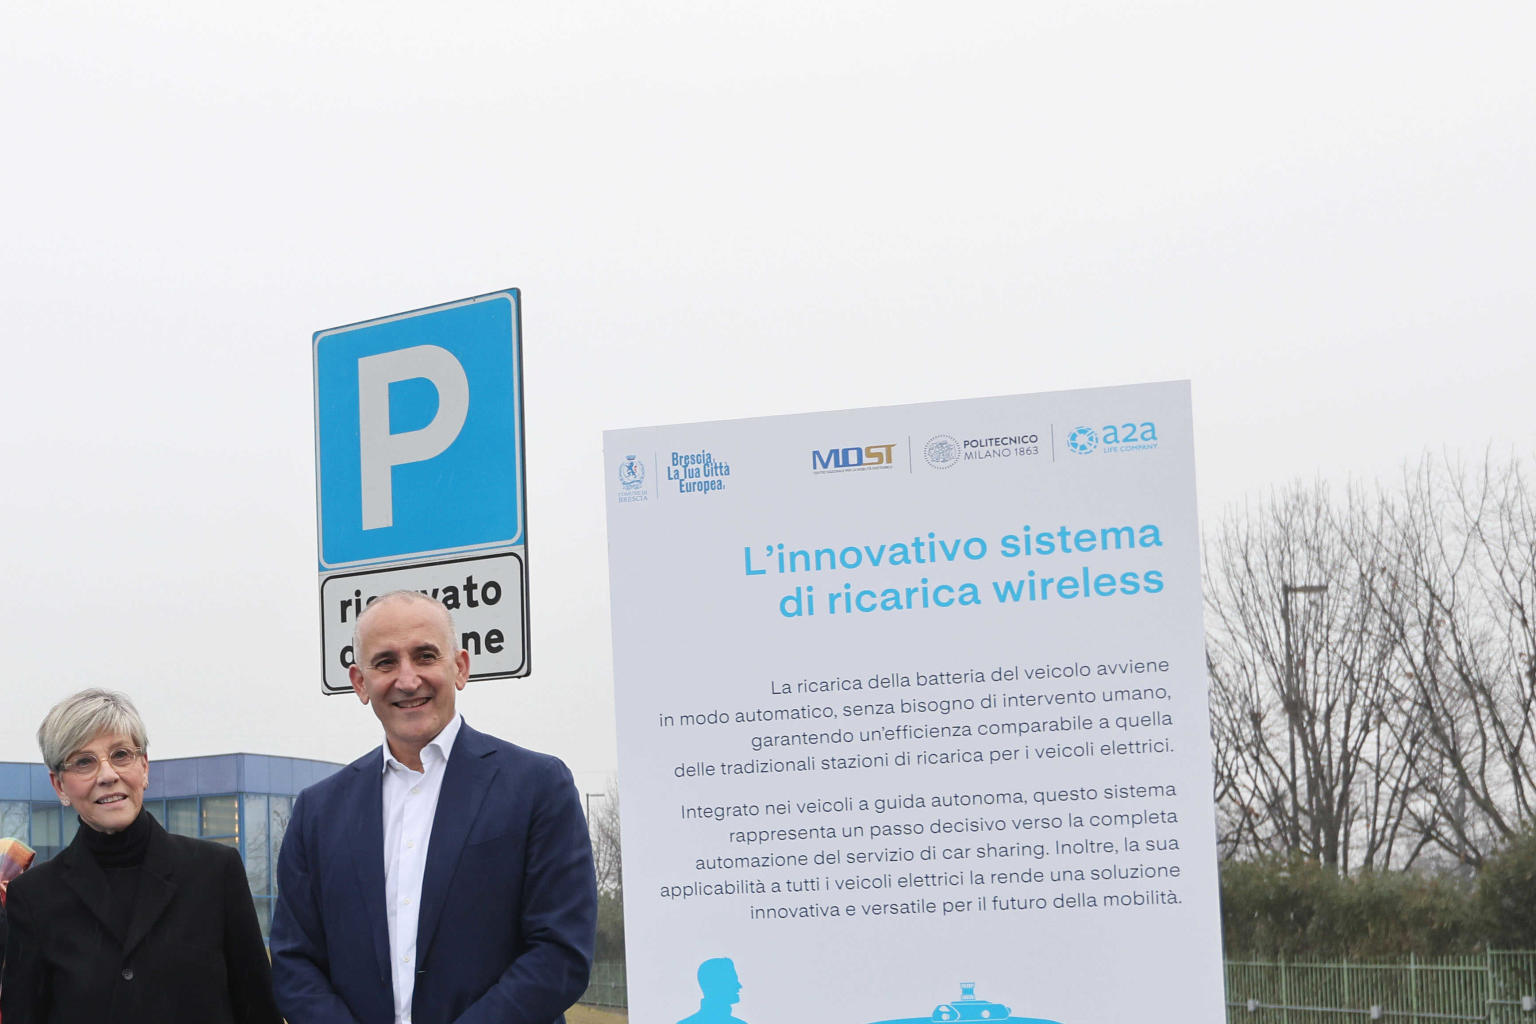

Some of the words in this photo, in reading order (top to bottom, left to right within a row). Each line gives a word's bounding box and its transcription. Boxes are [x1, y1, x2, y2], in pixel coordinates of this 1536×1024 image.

[357, 344, 470, 531] P
[964, 434, 1038, 448] POLITECNICO
[1102, 421, 1158, 444] a2a
[812, 444, 896, 470] MOST
[964, 448, 1011, 460] MILANO
[1014, 446, 1039, 456] 1863
[668, 466, 680, 480] La
[681, 464, 701, 480] Tua
[704, 462, 730, 477] Città
[1001, 524, 1163, 558] sistema
[340, 575, 502, 623] riato
[780, 586, 814, 618] di
[829, 578, 981, 614] ricarica
[992, 566, 1164, 603] wireless
[772, 681, 792, 695] La
[798, 677, 863, 693] ricarica
[868, 673, 911, 689] della
[917, 669, 986, 686] batteria
[991, 666, 1018, 681] del
[1024, 662, 1090, 679] veicolo
[1097, 660, 1169, 675] avviene
[660, 714, 674, 727] in
[680, 710, 729, 726] modo
[736, 705, 837, 722] automatico,
[843, 704, 895, 716] senza
[901, 699, 974, 714] bisogno
[981, 694, 996, 708] di
[1003, 690, 1096, 707] intervento
[1103, 688, 1170, 702] umano,
[752, 729, 853, 751] garantendo
[978, 716, 1092, 736] comparabile
[1100, 718, 1110, 729] a
[1116, 711, 1173, 731] quella
[674, 762, 715, 777] delle
[720, 756, 814, 775] tradizionali
[821, 753, 888, 770] stazioni
[895, 752, 910, 766] di
[917, 749, 984, 765] ricarica
[990, 749, 1020, 764] per
[1026, 746, 1028, 759] i
[1035, 742, 1093, 759] veicoli
[1101, 738, 1174, 756] elettrici.
[682, 804, 759, 821] Integrato
[766, 800, 790, 814] nei
[796, 797, 852, 814] veicoli
[859, 800, 869, 810] a
[874, 794, 926, 814] guida
[932, 792, 1027, 807] autonoma,
[1034, 788, 1097, 805] questo
[1104, 784, 1176, 799] sistema
[730, 826, 836, 845] rappresenta
[842, 826, 863, 838] un
[870, 824, 924, 840] passo
[930, 818, 1006, 834] decisivo
[1012, 818, 1062, 830] verso
[1069, 813, 1084, 827] la
[1090, 810, 1178, 828] completa
[696, 853, 808, 870] automazione
[814, 850, 840, 865] del
[847, 848, 914, 864] servizio
[920, 846, 936, 860] di
[942, 848, 971, 859] car
[977, 842, 1049, 859] sharing.
[1056, 839, 1118, 854] Inoltre,
[1125, 837, 1140, 852] la
[1146, 839, 1180, 851] sua
[661, 880, 766, 900] applicabilità
[772, 882, 781, 893] a
[786, 877, 819, 892] tutti
[826, 877, 828, 890] i
[835, 874, 891, 890] veicoli
[898, 872, 963, 888] elettrici
[970, 870, 985, 884] la
[991, 868, 1044, 884] rende
[1051, 870, 1085, 882] una
[1091, 864, 1180, 880] soluzione
[751, 904, 840, 919] innovativa
[846, 905, 856, 916] e
[862, 898, 936, 915] versatile
[943, 901, 972, 916] per
[978, 896, 986, 911] il
[992, 896, 1046, 911] futuro
[1053, 892, 1098, 908] della
[1104, 890, 1182, 906] mobilità.
